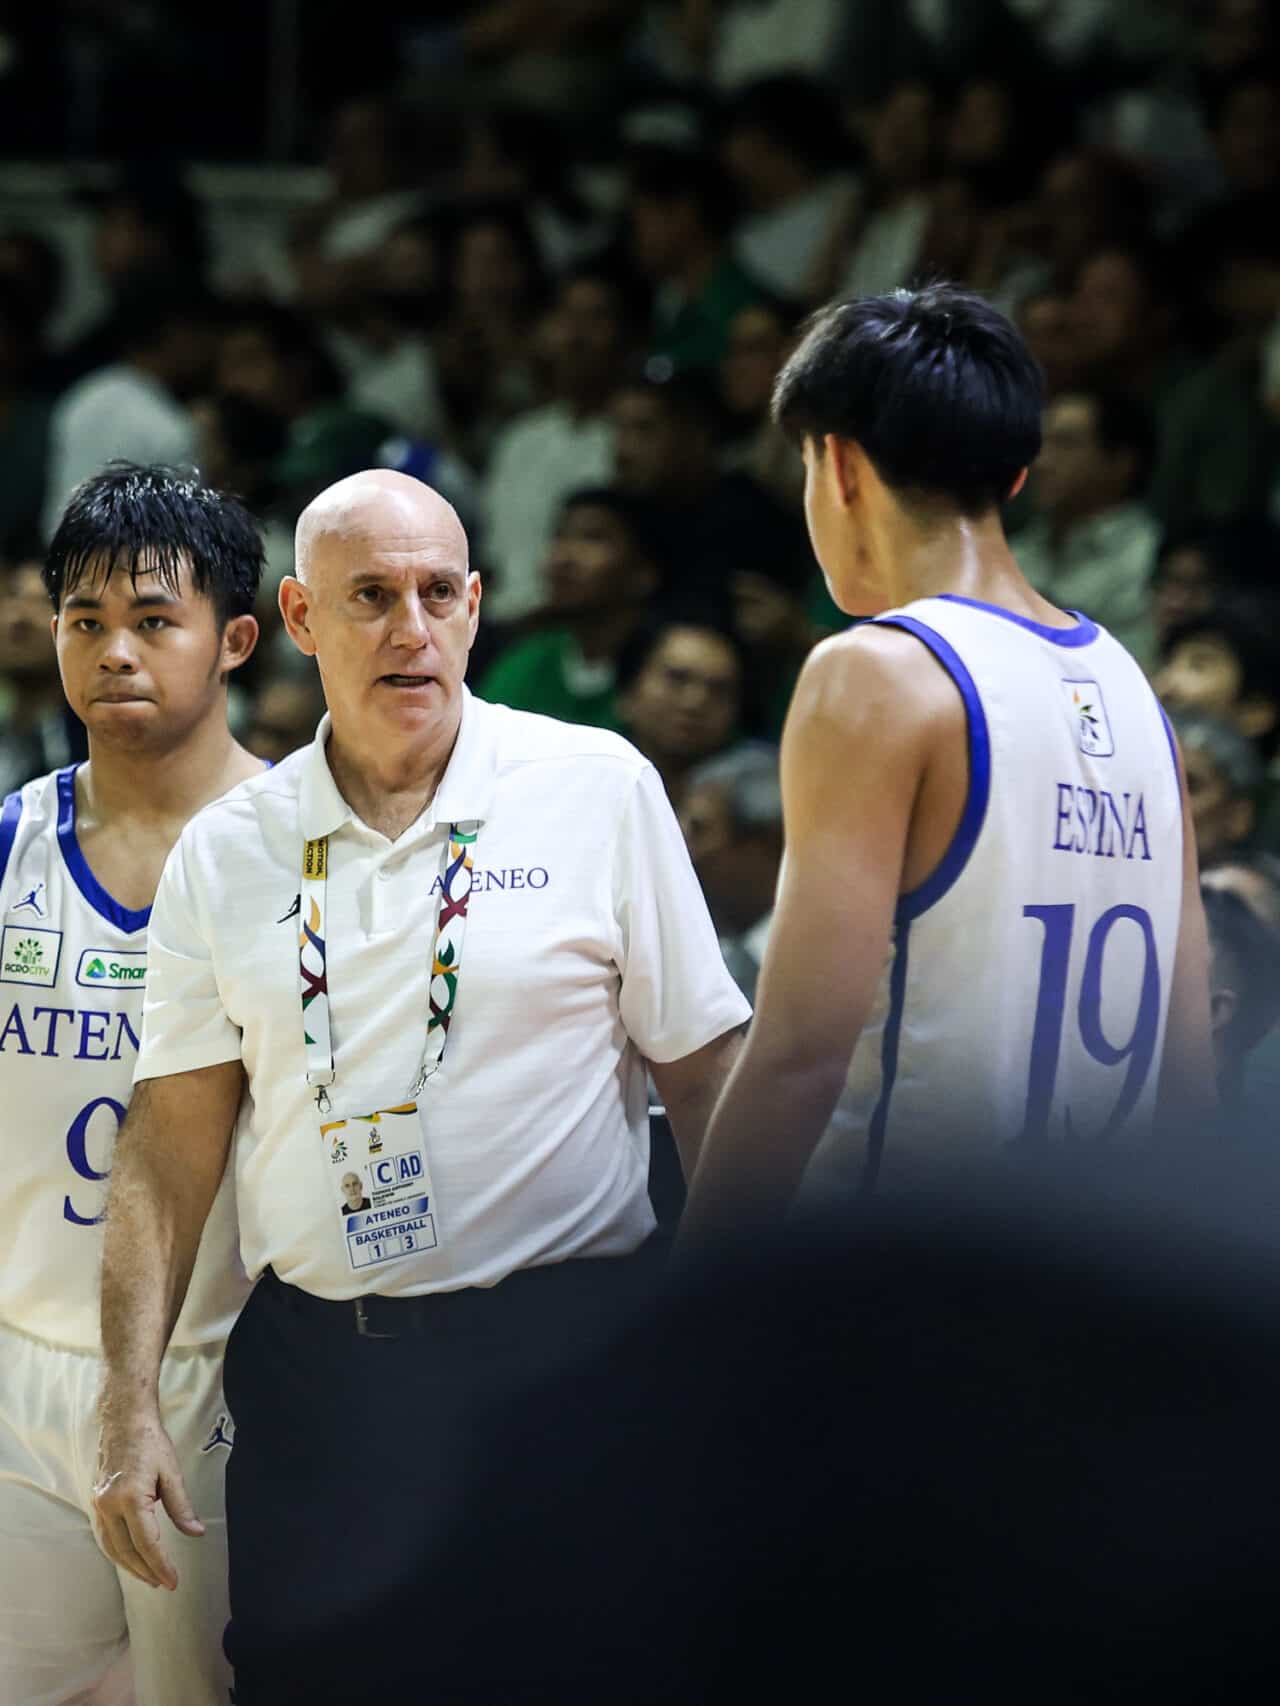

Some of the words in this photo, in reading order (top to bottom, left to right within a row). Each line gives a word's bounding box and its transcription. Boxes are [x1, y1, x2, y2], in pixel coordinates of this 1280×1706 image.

[1052, 782, 1153, 861] ESPINA
[427, 867, 549, 896] AENEO
[108, 962, 148, 980] Smar
[1022, 903, 1162, 1148] 19
[63, 1096, 128, 1226] 9
[376, 1161, 393, 1184] C
[400, 1154, 421, 1180] AD
[365, 1205, 410, 1225] ATENEO
[355, 1219, 427, 1246] BASKETBALL
[374, 1244, 382, 1257] 1
[405, 1236, 414, 1250] 3
